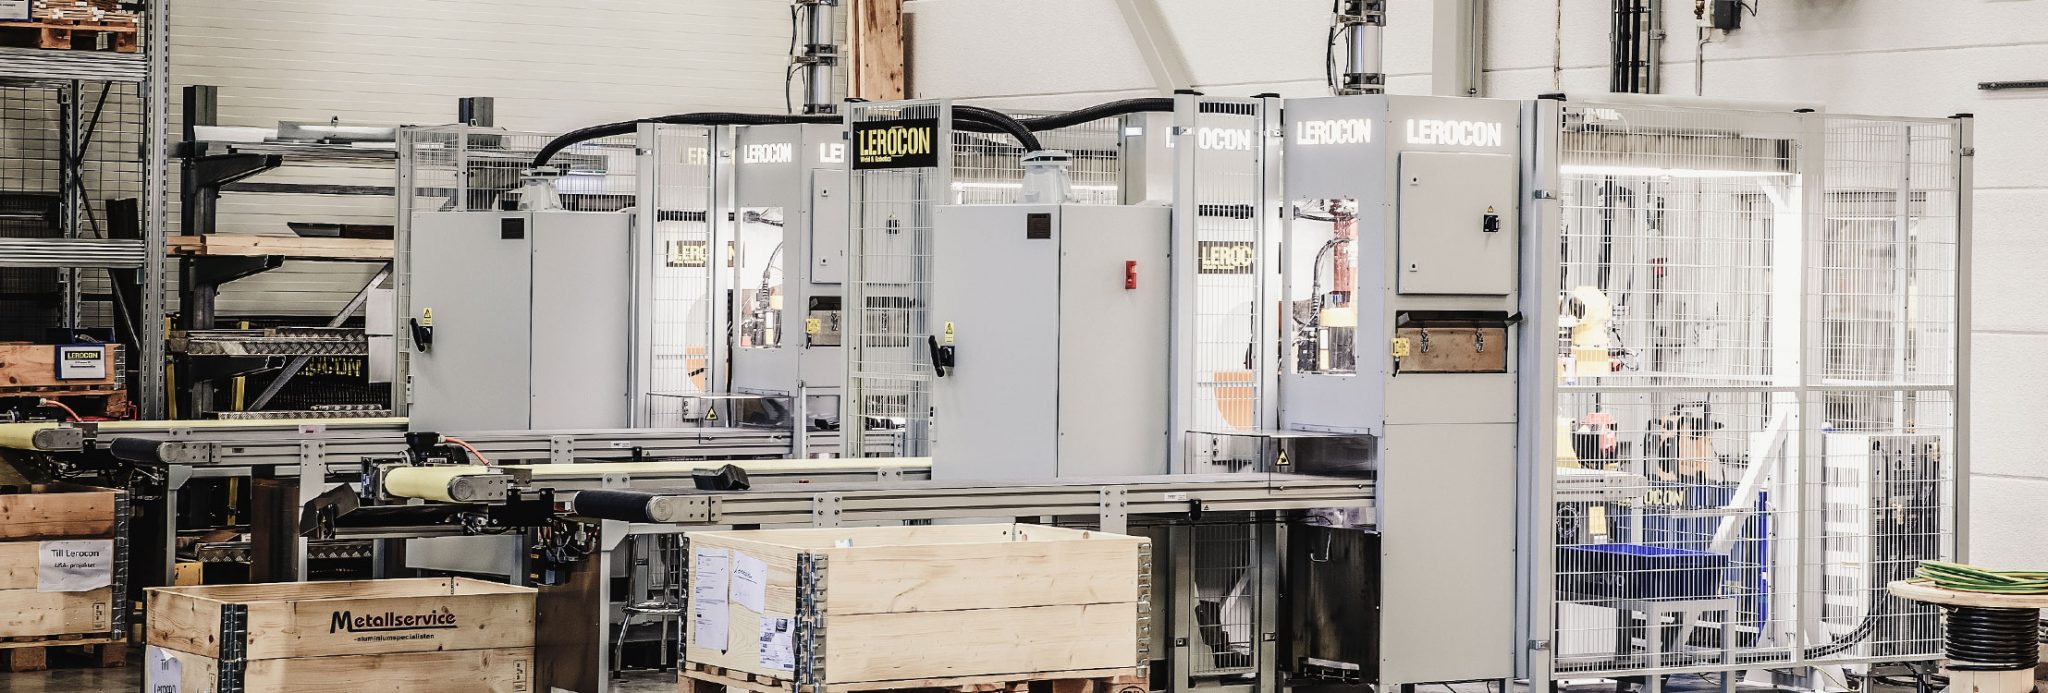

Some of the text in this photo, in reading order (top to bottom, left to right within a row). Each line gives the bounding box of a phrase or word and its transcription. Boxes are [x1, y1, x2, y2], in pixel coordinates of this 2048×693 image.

[860, 127, 931, 155] LEROCON
[1165, 127, 1251, 150] LOCON
[1297, 119, 1371, 145] LEROCON
[1407, 119, 1502, 146] LEROCON
[743, 143, 792, 164] LEROCON
[1202, 246, 1253, 267] LEROC
[51, 549, 99, 557] Till Lerocon
[330, 610, 456, 633] Metallservice
